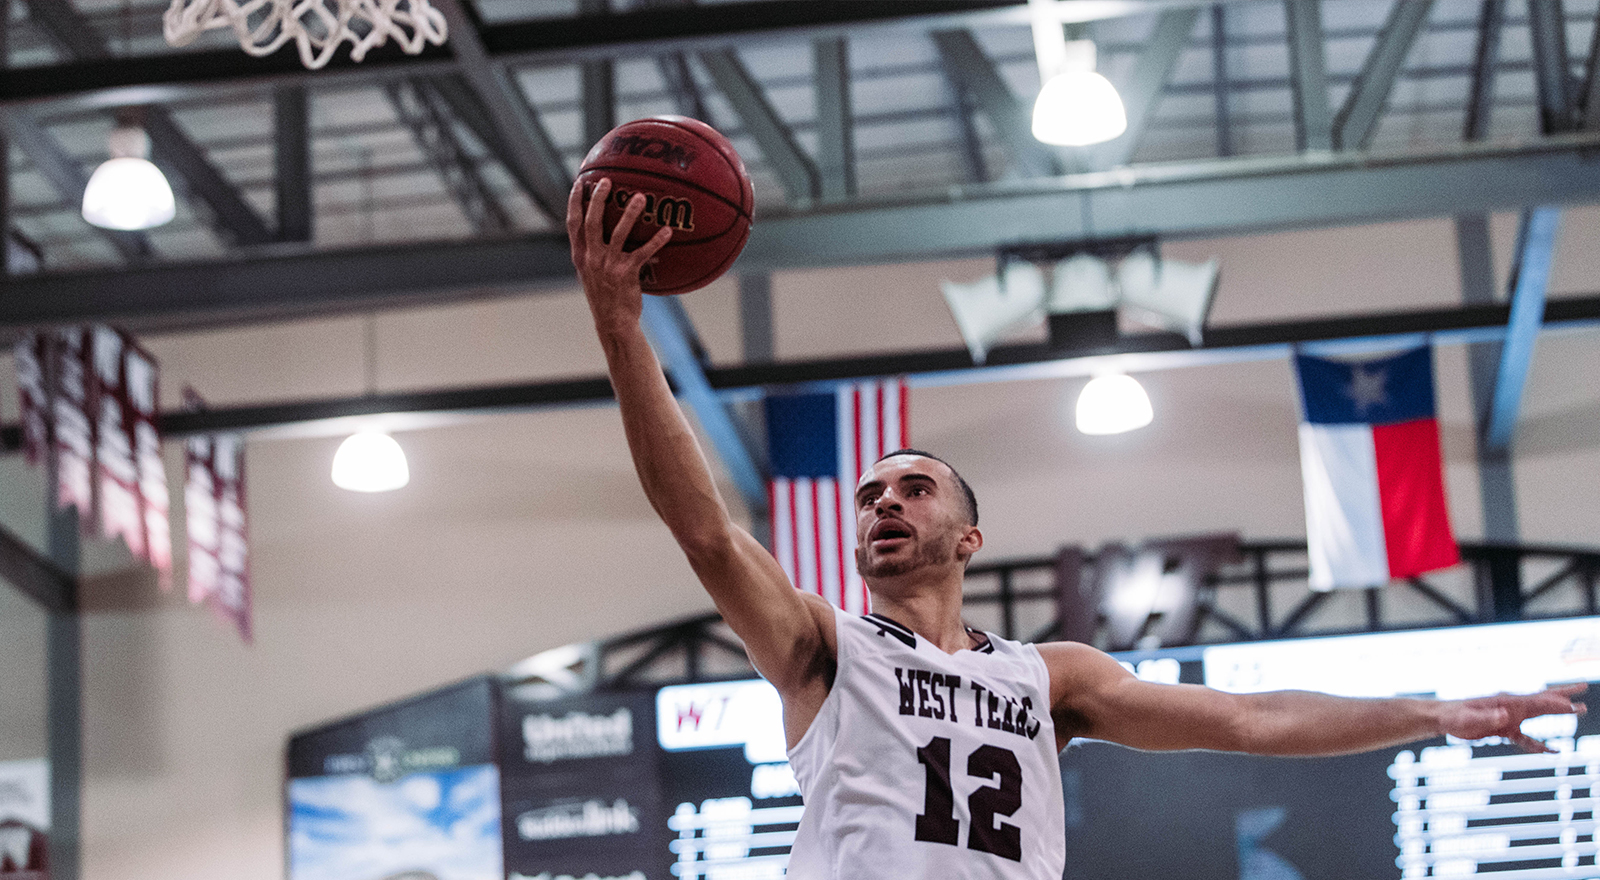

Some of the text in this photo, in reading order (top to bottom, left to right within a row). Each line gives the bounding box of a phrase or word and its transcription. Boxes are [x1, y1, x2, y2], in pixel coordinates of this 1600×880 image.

[582, 180, 695, 232] Wisn
[895, 667, 1041, 741] WEST TEXAS
[914, 736, 1022, 862] 12
